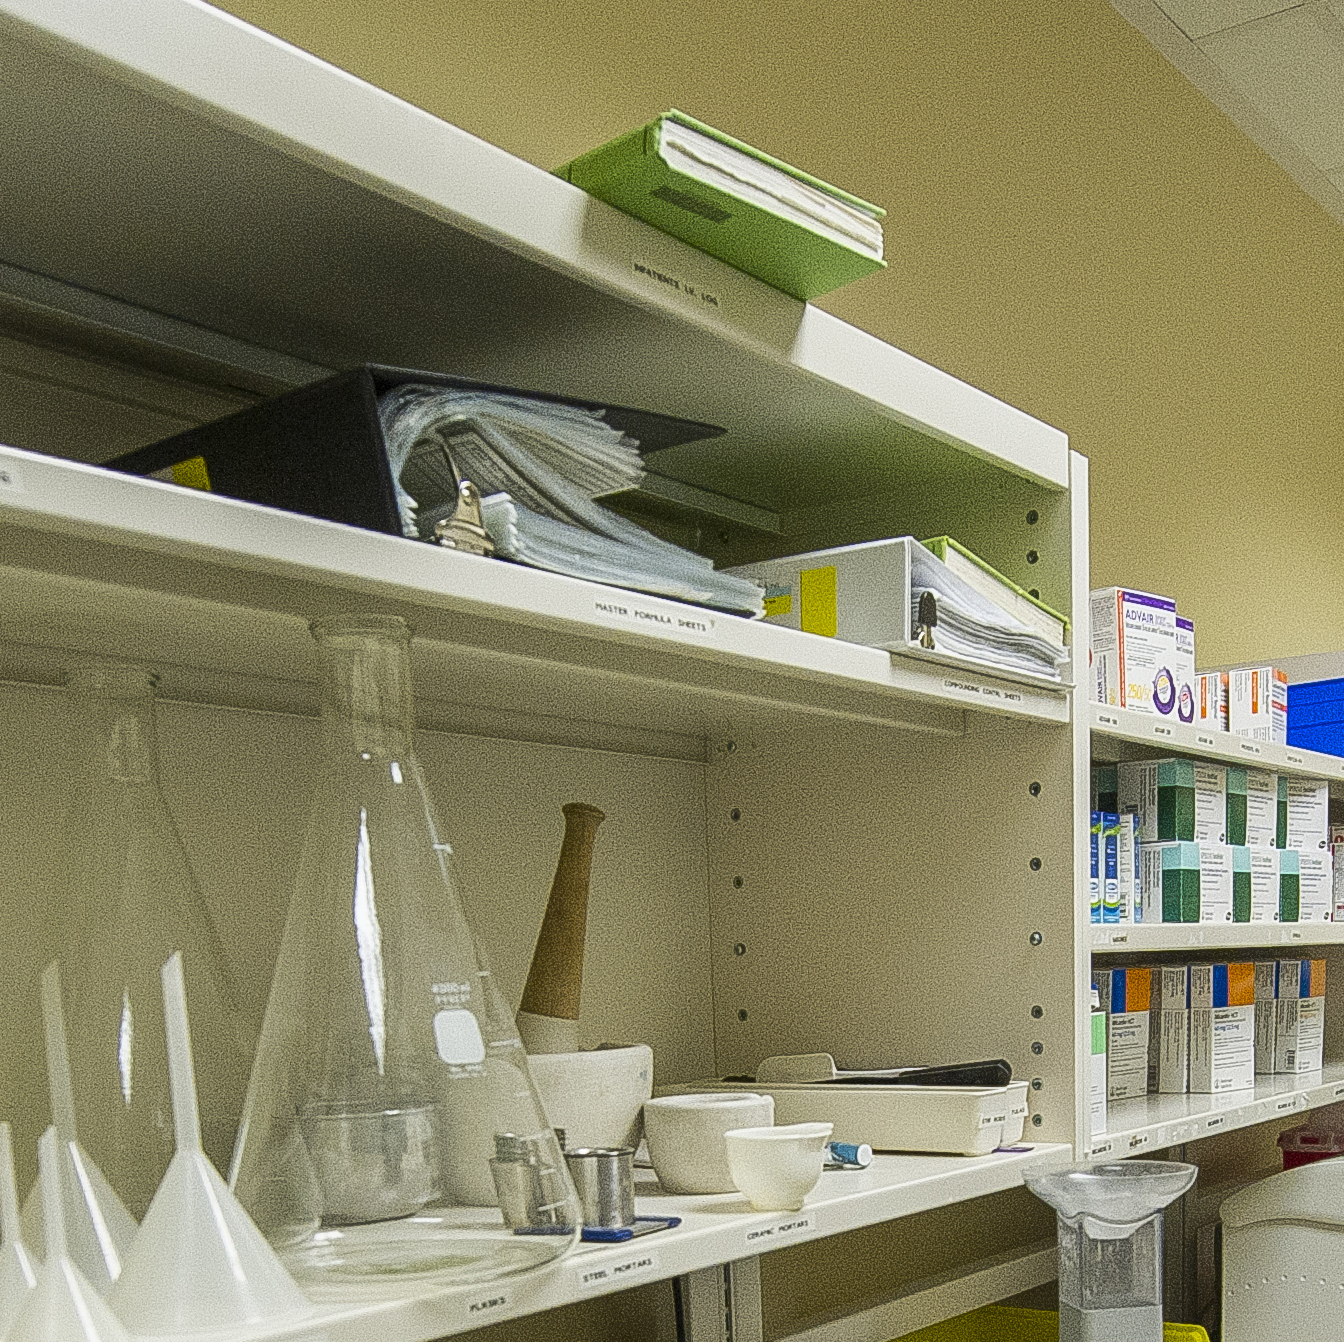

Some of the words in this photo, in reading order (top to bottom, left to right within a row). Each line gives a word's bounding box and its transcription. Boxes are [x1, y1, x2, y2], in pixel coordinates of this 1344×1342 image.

[595, 602, 628, 616] MASTER
[634, 609, 672, 625] FORMULA
[677, 618, 706, 632] SHEETS
[1125, 608, 1154, 624] ADVAIR
[747, 1227, 774, 1240] CERAMIC
[778, 1220, 809, 1232] MORTARS
[583, 1267, 608, 1283] STEEL
[614, 1258, 653, 1277] MORTARS
[468, 1295, 507, 1312] FLASKS
